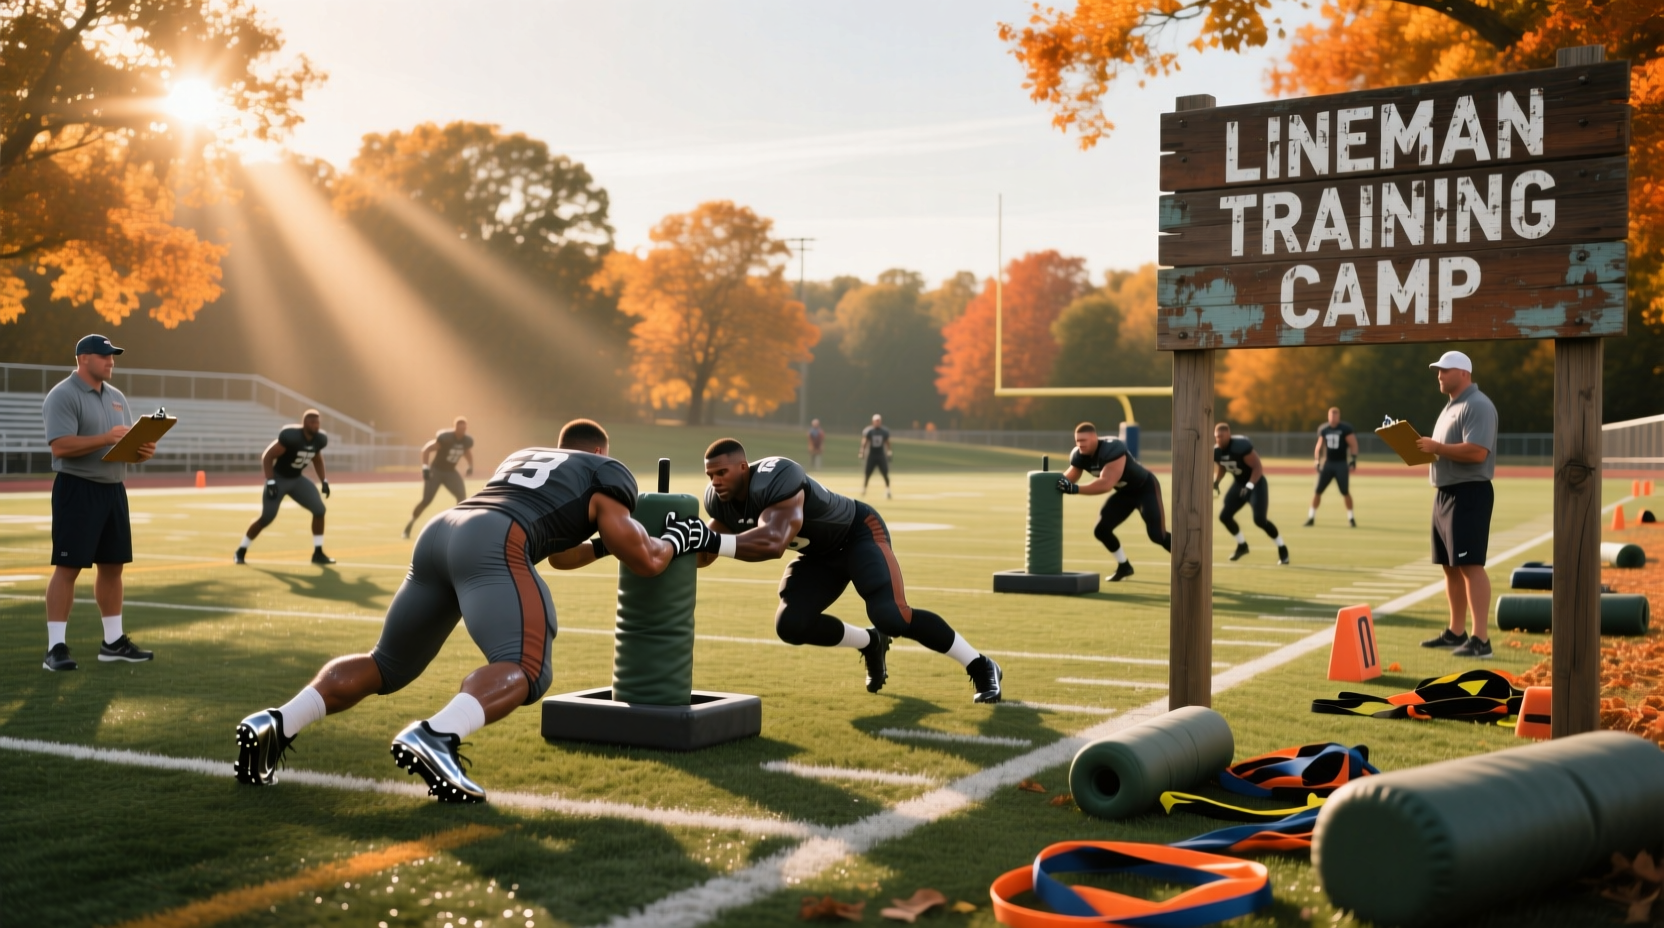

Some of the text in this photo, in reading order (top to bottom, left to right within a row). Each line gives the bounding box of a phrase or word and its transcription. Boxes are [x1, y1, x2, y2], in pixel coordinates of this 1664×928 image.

[1225, 87, 1544, 183] LINEMAN
[1219, 169, 1556, 257] TRAINING
[1280, 256, 1482, 330] CAMP
